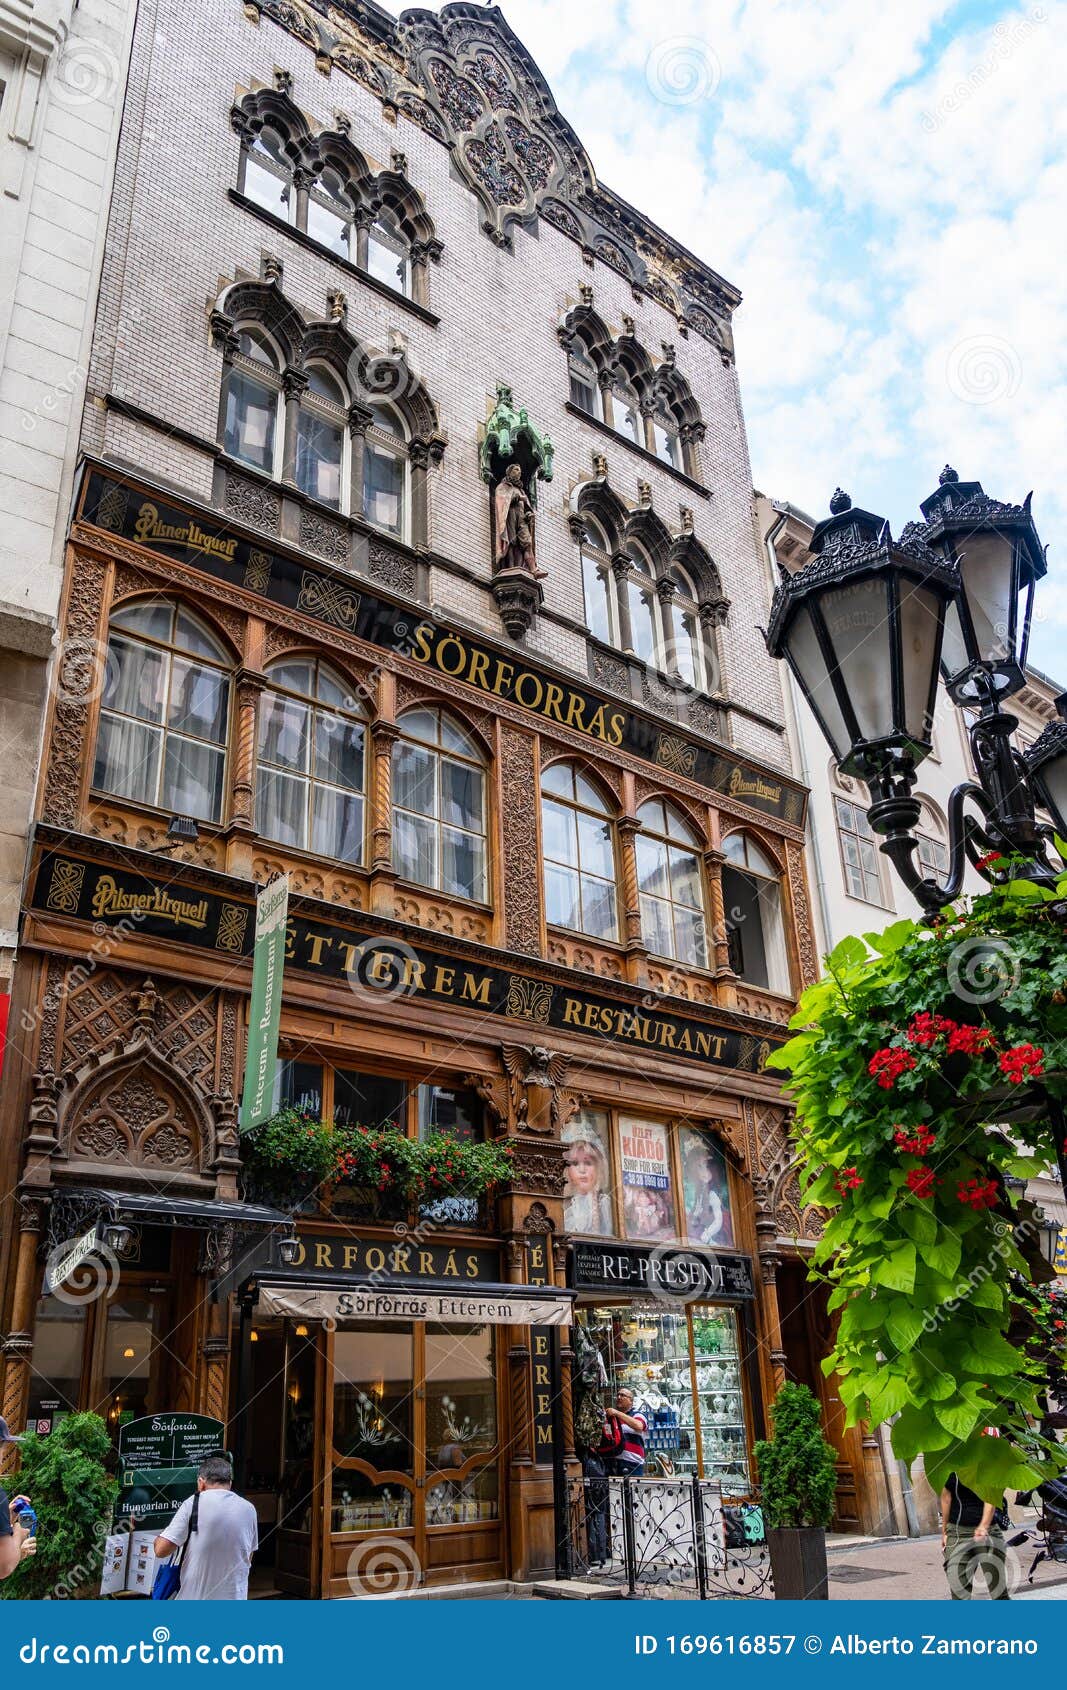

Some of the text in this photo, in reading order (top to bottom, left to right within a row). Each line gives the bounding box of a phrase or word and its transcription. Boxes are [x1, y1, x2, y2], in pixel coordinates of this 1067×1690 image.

[133, 502, 189, 542] Pilsner
[411, 626, 626, 747] SÖRFORRÁS
[92, 875, 208, 928] Pilsner Urquell
[260, 937, 277, 1031] Restaurant
[563, 997, 727, 1060] RESTAURANT
[622, 1135, 664, 1162] KIADÓ
[289, 1236, 479, 1278] ÖRFORRÁS
[602, 1254, 726, 1287] RE-PRESENT
[336, 1293, 428, 1317] Sörforrás
[531, 1246, 553, 1445] ÉTEREM
[151, 1416, 198, 1437] Sörforrás
[122, 1501, 169, 1513] Hungarian
